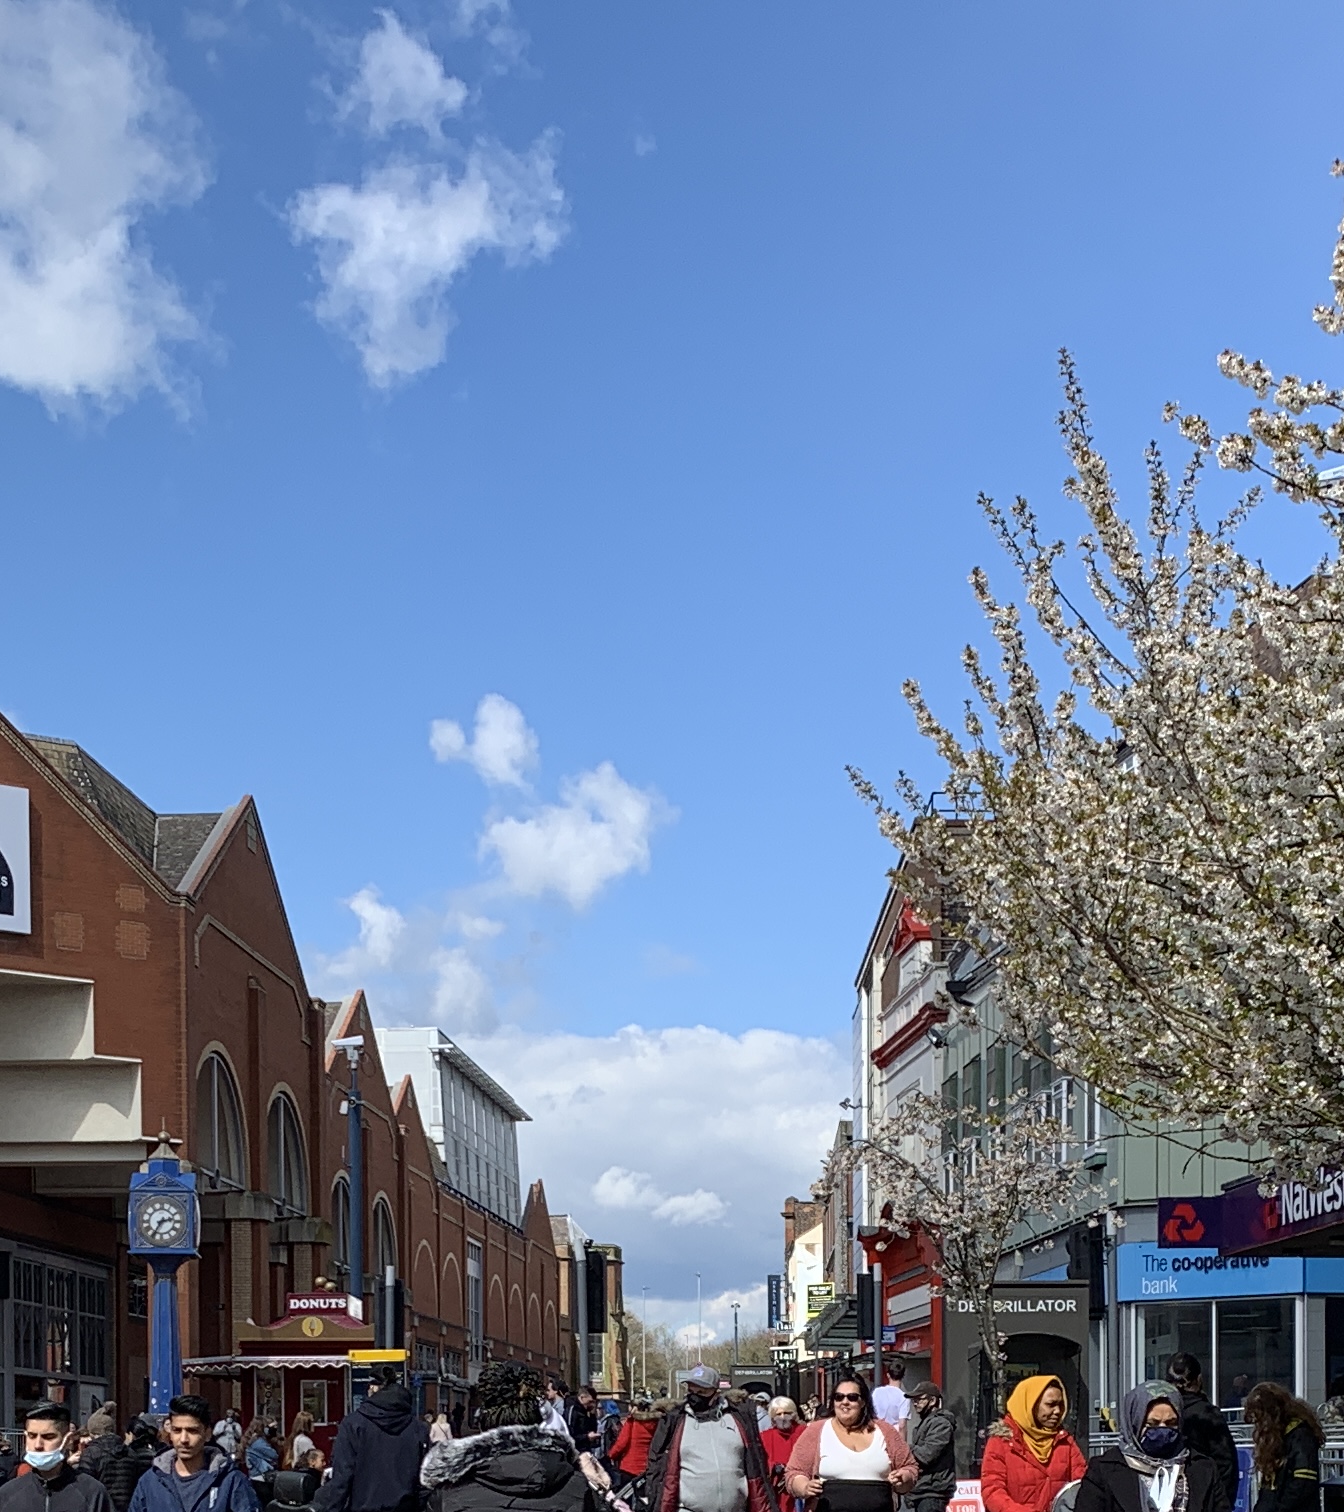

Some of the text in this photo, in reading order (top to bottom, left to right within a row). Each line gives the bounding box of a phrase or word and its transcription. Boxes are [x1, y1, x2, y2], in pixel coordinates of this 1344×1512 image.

[1142, 1255, 1270, 1276] The co-operative
[1141, 1278, 1179, 1295] bank
[289, 1298, 347, 1309] DONUTS
[958, 1299, 1077, 1313] DEBRILLATOR
